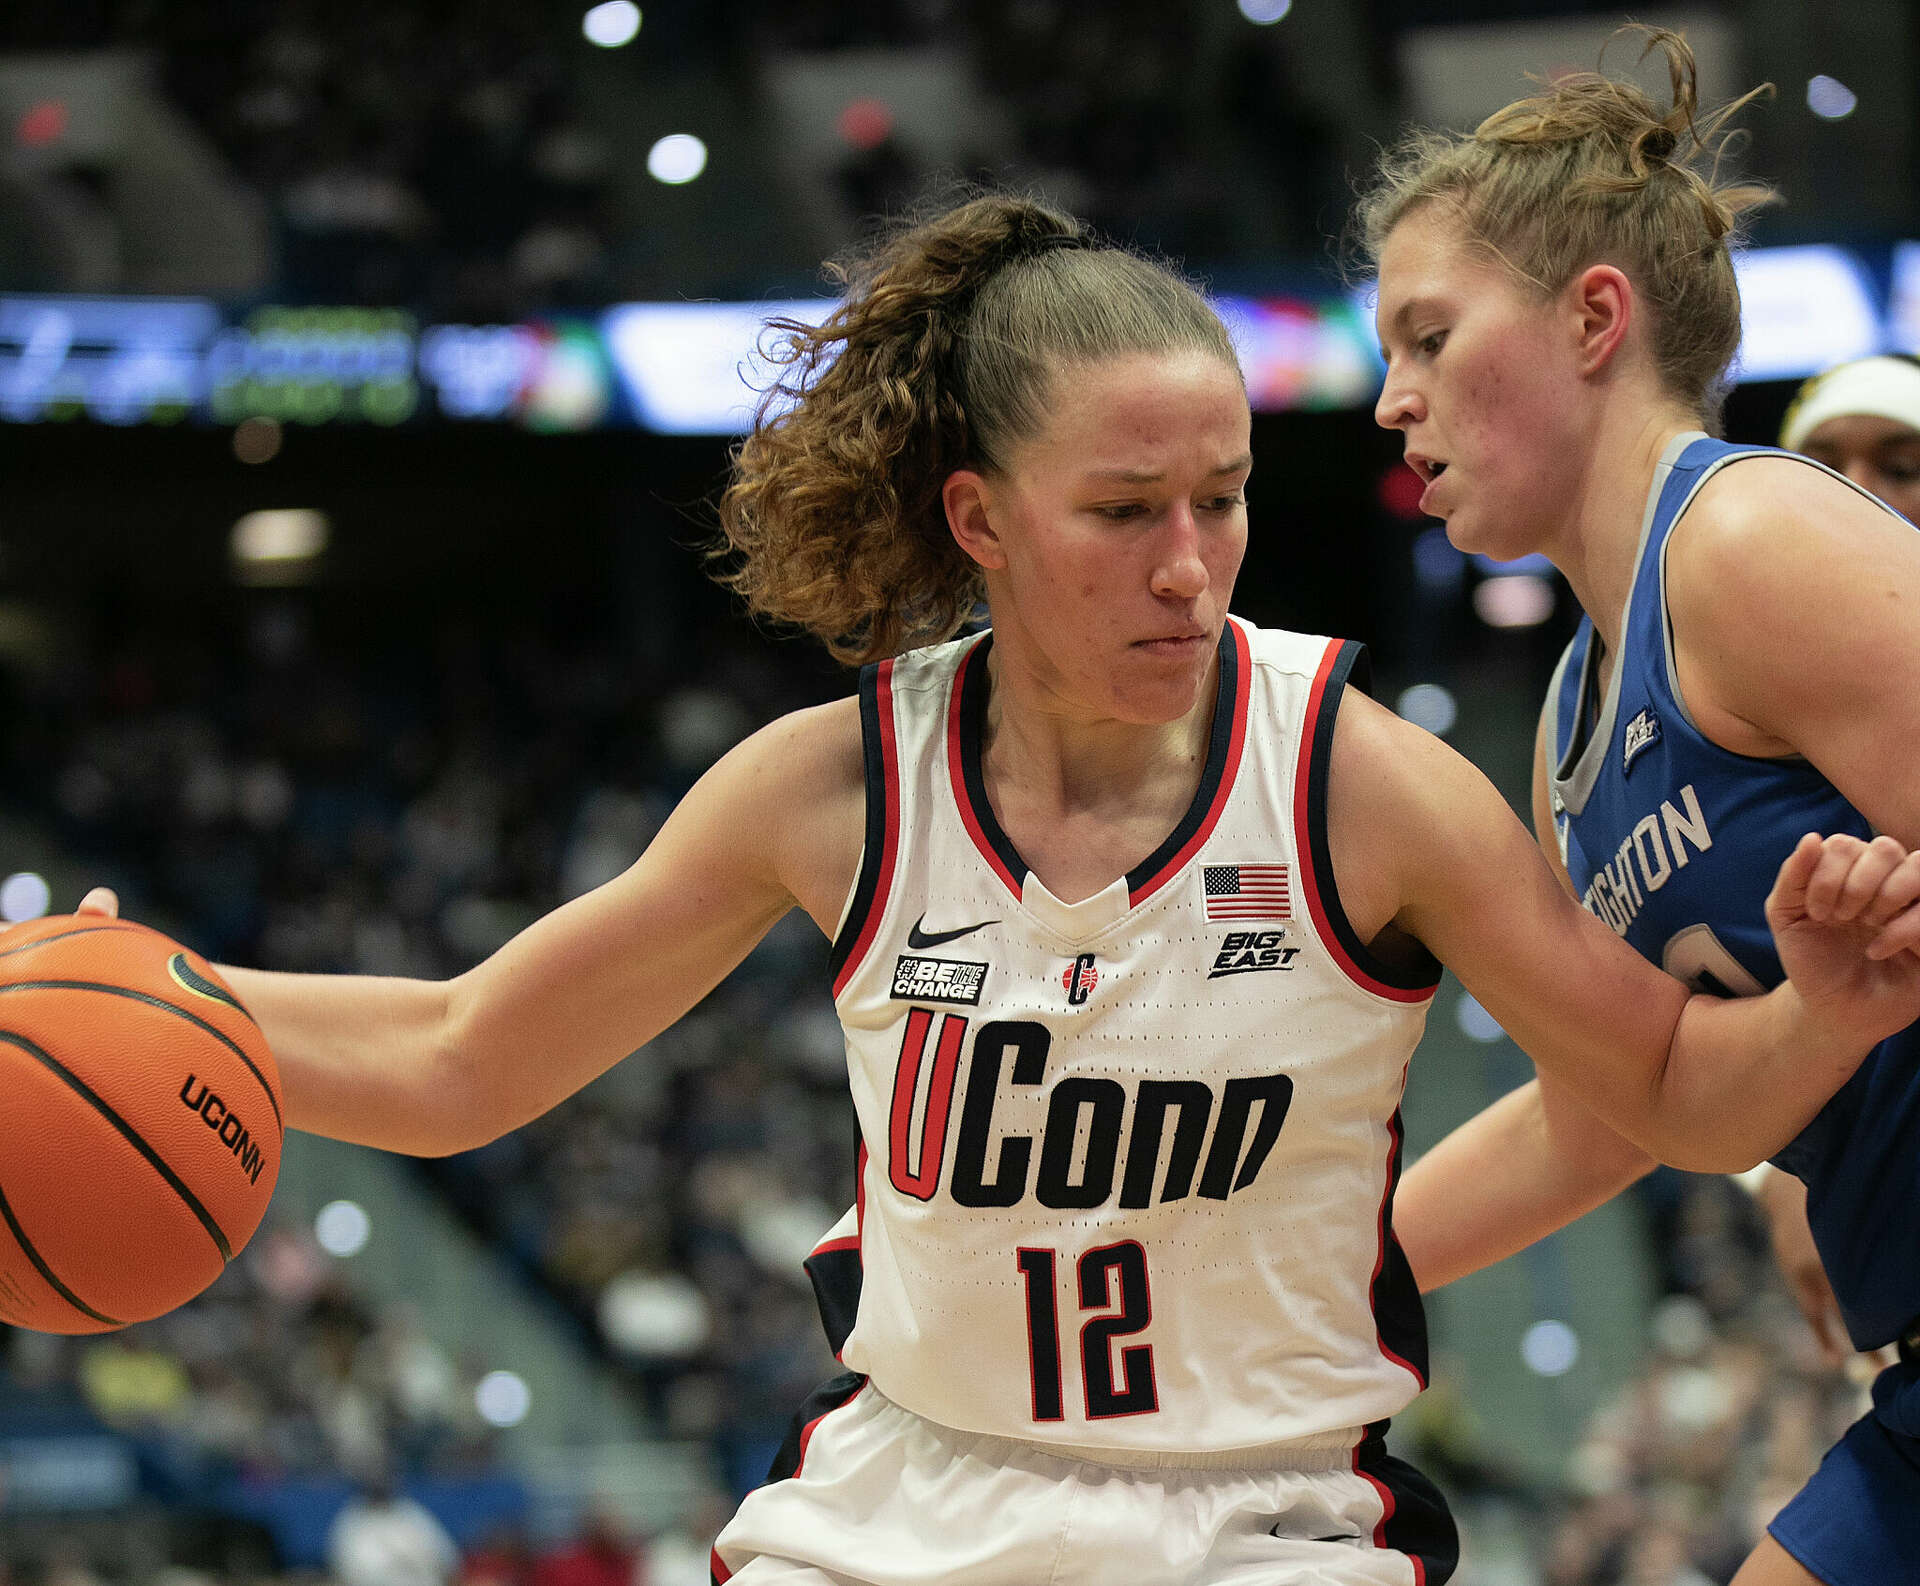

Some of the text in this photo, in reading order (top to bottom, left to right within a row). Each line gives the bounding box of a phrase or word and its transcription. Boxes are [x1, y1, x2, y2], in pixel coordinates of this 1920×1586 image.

[1221, 930, 1285, 950] BIG
[1213, 948, 1301, 968] EAST
[893, 979, 979, 1000] CHANGE
[179, 1074, 266, 1187] UCONN
[1016, 1239, 1159, 1421] 12
